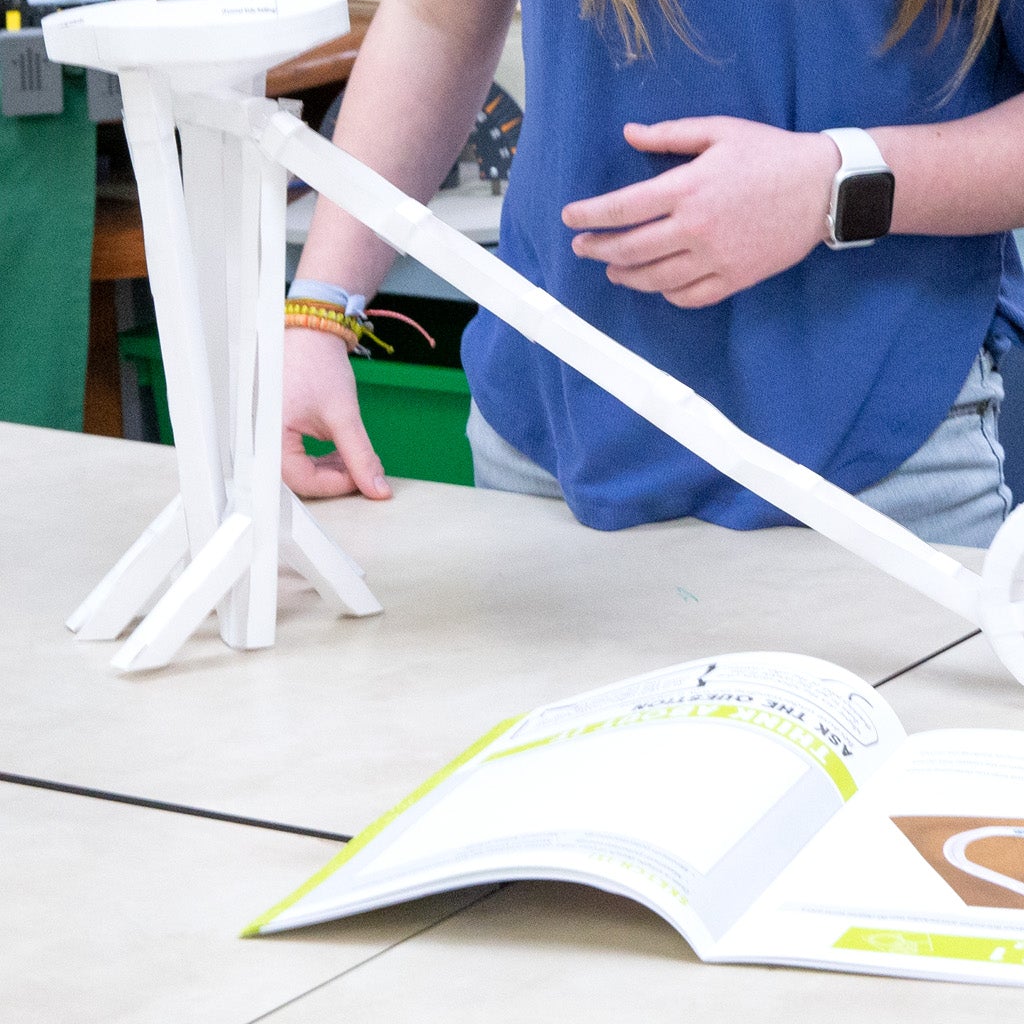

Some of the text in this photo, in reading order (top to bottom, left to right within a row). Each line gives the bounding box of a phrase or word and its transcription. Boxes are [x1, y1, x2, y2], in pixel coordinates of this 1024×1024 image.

[631, 693, 852, 757] ASK THE QUESTION
[736, 706, 833, 764] THINK
